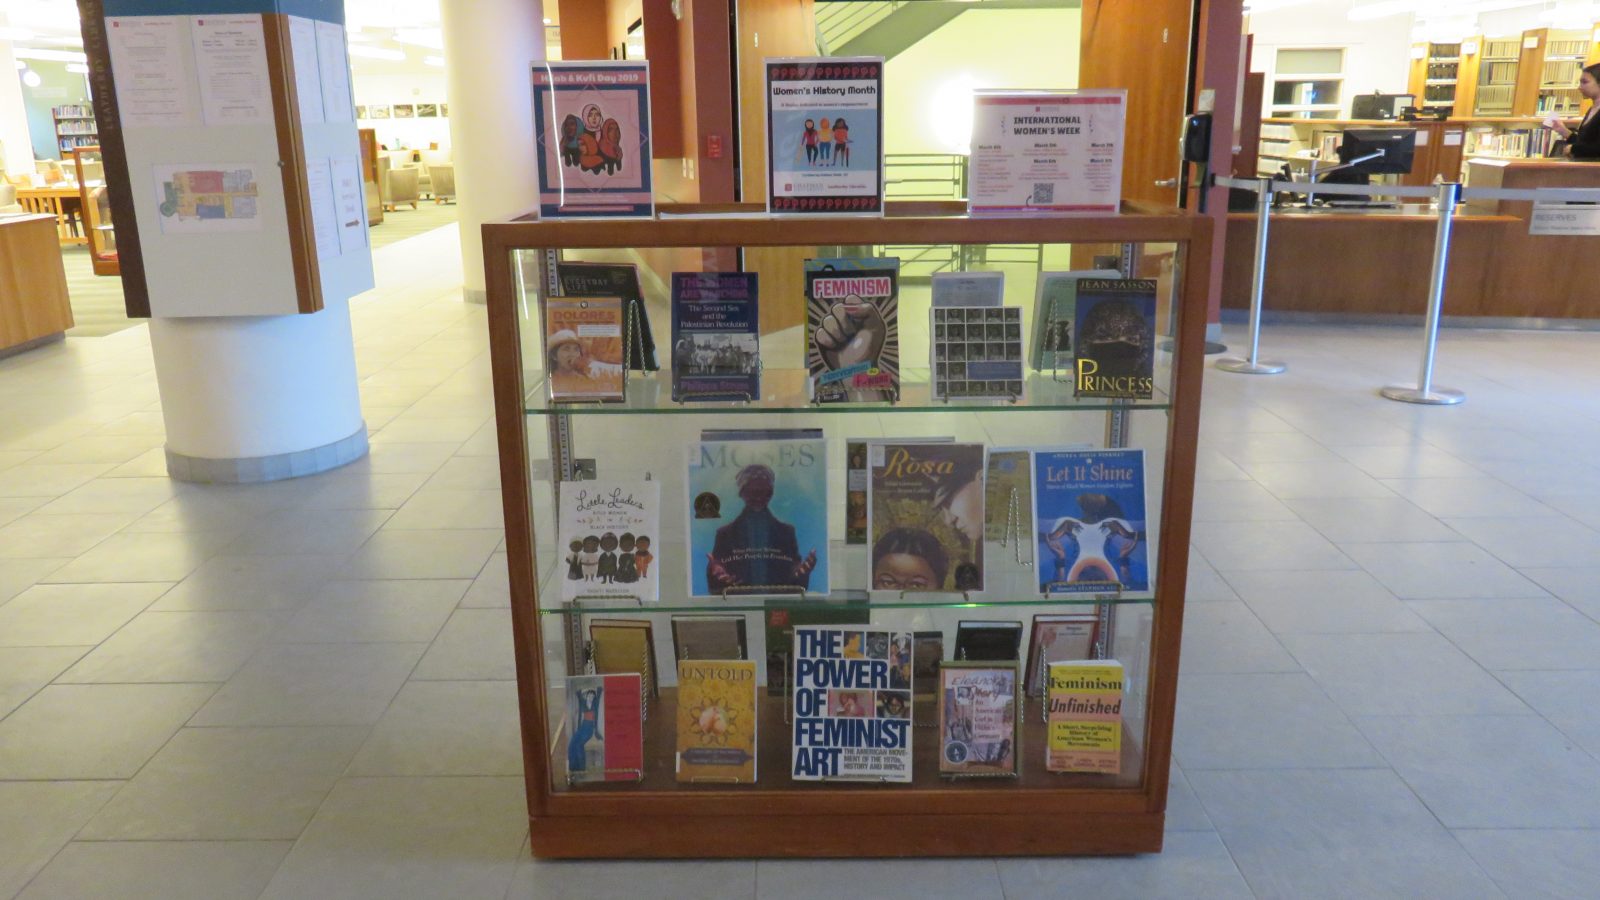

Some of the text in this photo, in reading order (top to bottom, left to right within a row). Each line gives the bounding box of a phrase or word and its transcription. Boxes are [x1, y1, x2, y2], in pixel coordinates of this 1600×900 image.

[597, 74, 617, 84] Day
[617, 73, 638, 82] 2019
[773, 86, 876, 96] Women's History Month
[1014, 116, 1081, 124] INTERNATIONAL
[1014, 127, 1056, 135] WOMEN'S
[815, 279, 890, 296] FEMINISM
[1081, 280, 1110, 289] JEAN
[1112, 280, 1155, 289] SASSON
[553, 311, 615, 320] DOLORES
[1077, 358, 1152, 392] PRINCESS
[700, 444, 815, 468] MOSES
[883, 447, 955, 478] Rosa
[1047, 463, 1133, 481] Let It Shine
[796, 630, 842, 658] THE
[682, 667, 753, 681] UNTOLD
[796, 659, 888, 689] POWER
[1050, 677, 1122, 690] Feminism
[796, 688, 827, 717] OF
[1049, 697, 1121, 714] Unfinished
[795, 718, 910, 748] FEMINIST
[794, 748, 842, 776] ART
